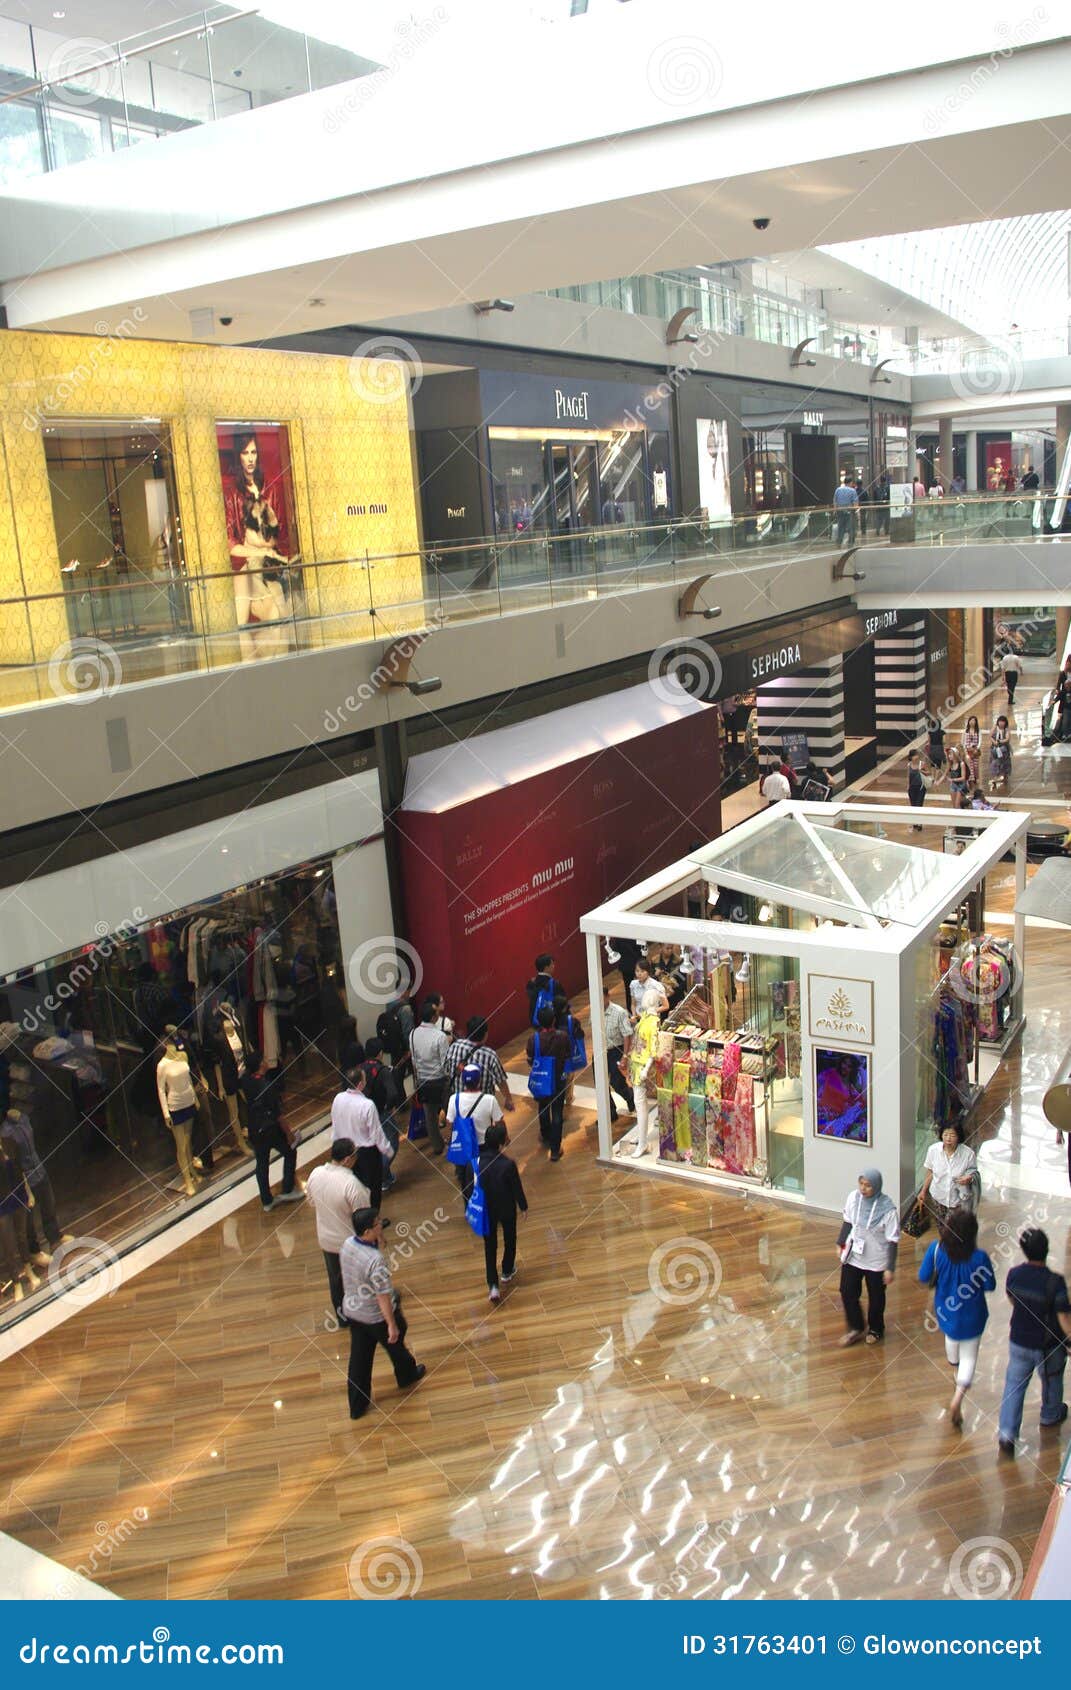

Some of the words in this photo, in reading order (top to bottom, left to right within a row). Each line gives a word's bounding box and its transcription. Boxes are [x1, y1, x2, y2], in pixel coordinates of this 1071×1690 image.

[555, 390, 588, 420] PIAGET
[803, 411, 824, 426] BALLY
[865, 609, 898, 635] SEPHORA
[751, 643, 801, 678] SEPHORA
[464, 911, 477, 924] THE
[476, 897, 502, 918] SHOPPES
[502, 882, 529, 904] PRESENTS
